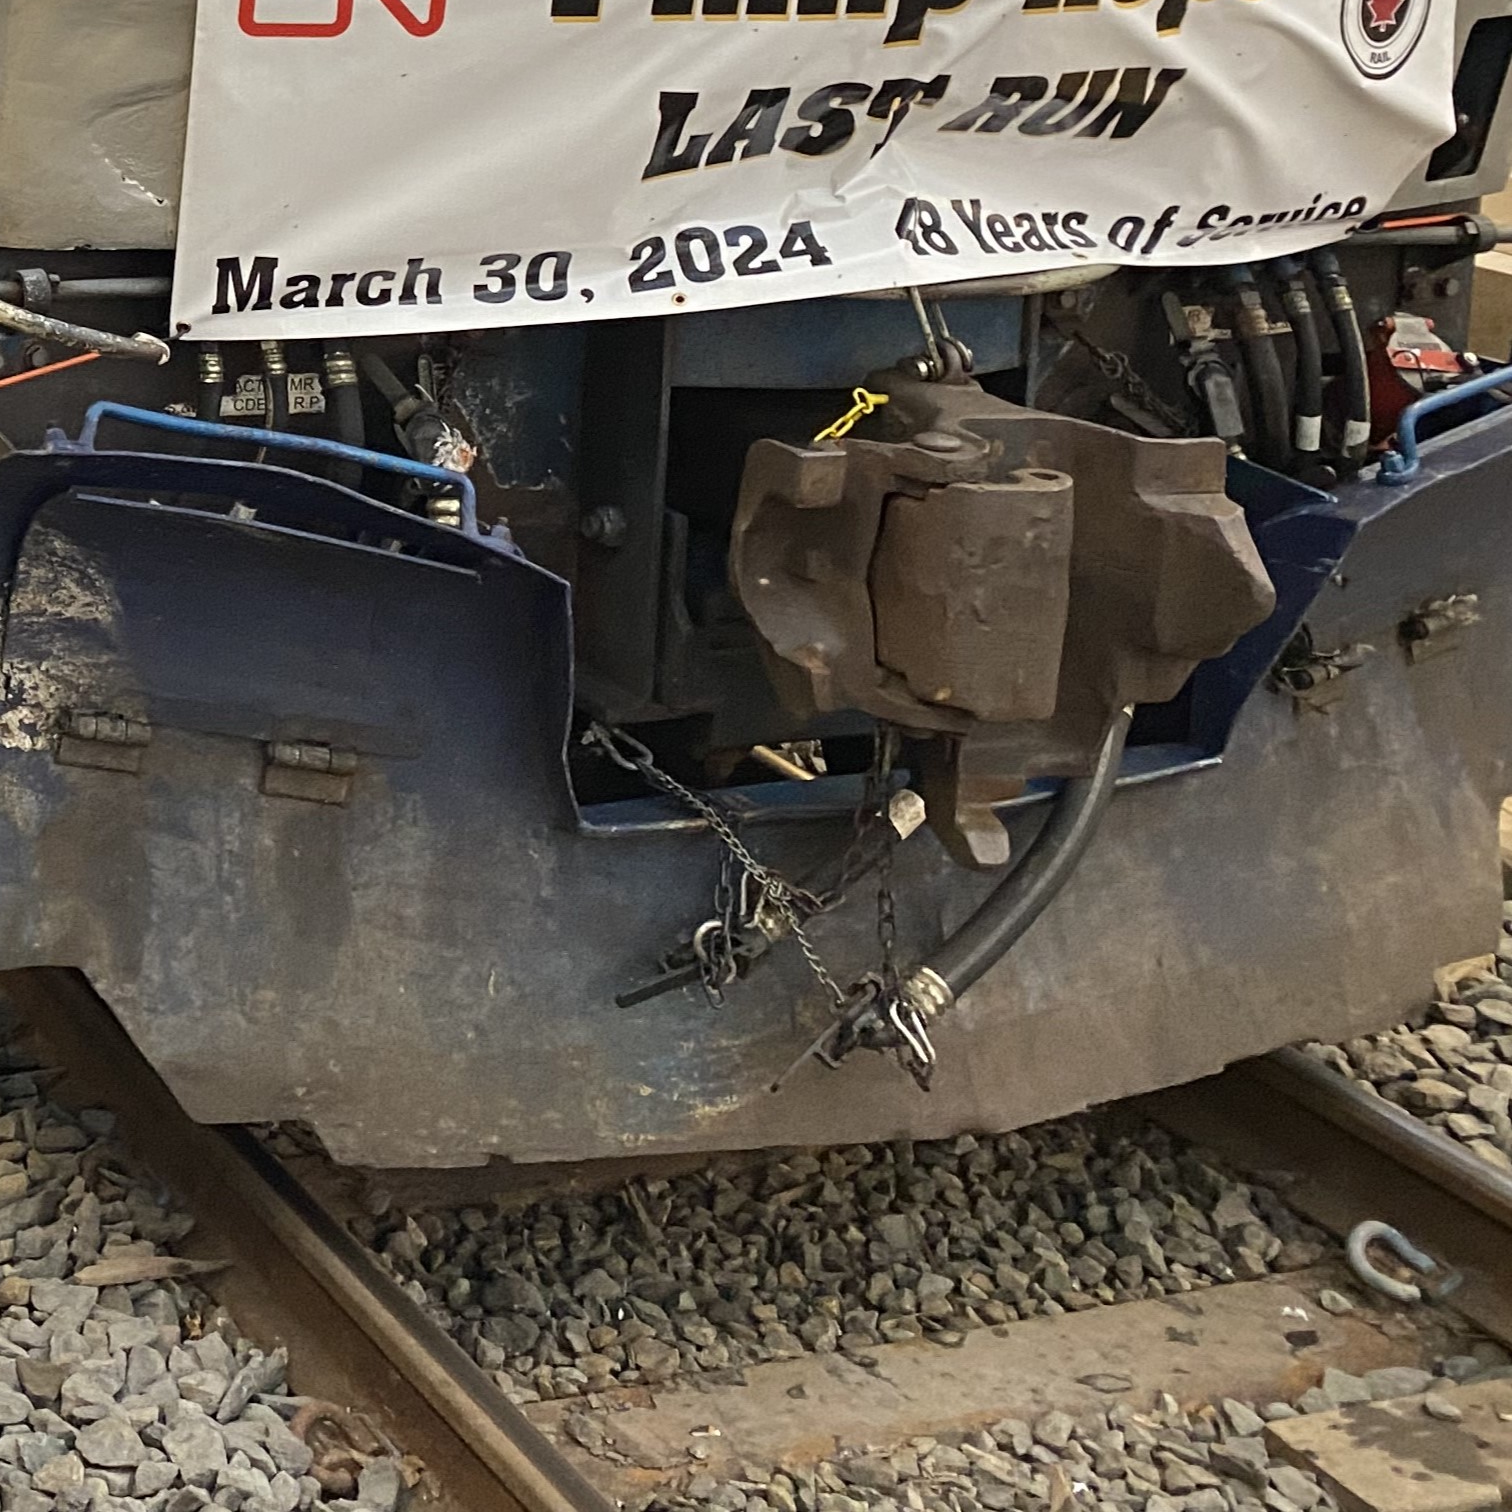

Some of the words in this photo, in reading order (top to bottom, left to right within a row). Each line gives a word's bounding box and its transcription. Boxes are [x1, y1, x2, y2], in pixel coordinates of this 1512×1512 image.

[1369, 51, 1392, 64] RAIL
[641, 74, 951, 182] LAST
[938, 68, 1187, 140] RUN
[212, 258, 443, 315] March
[473, 251, 595, 305] 30,
[628, 221, 833, 293] 2024
[951, 198, 1098, 254] Years
[1107, 204, 1181, 255] of
[290, 379, 314, 392] MR
